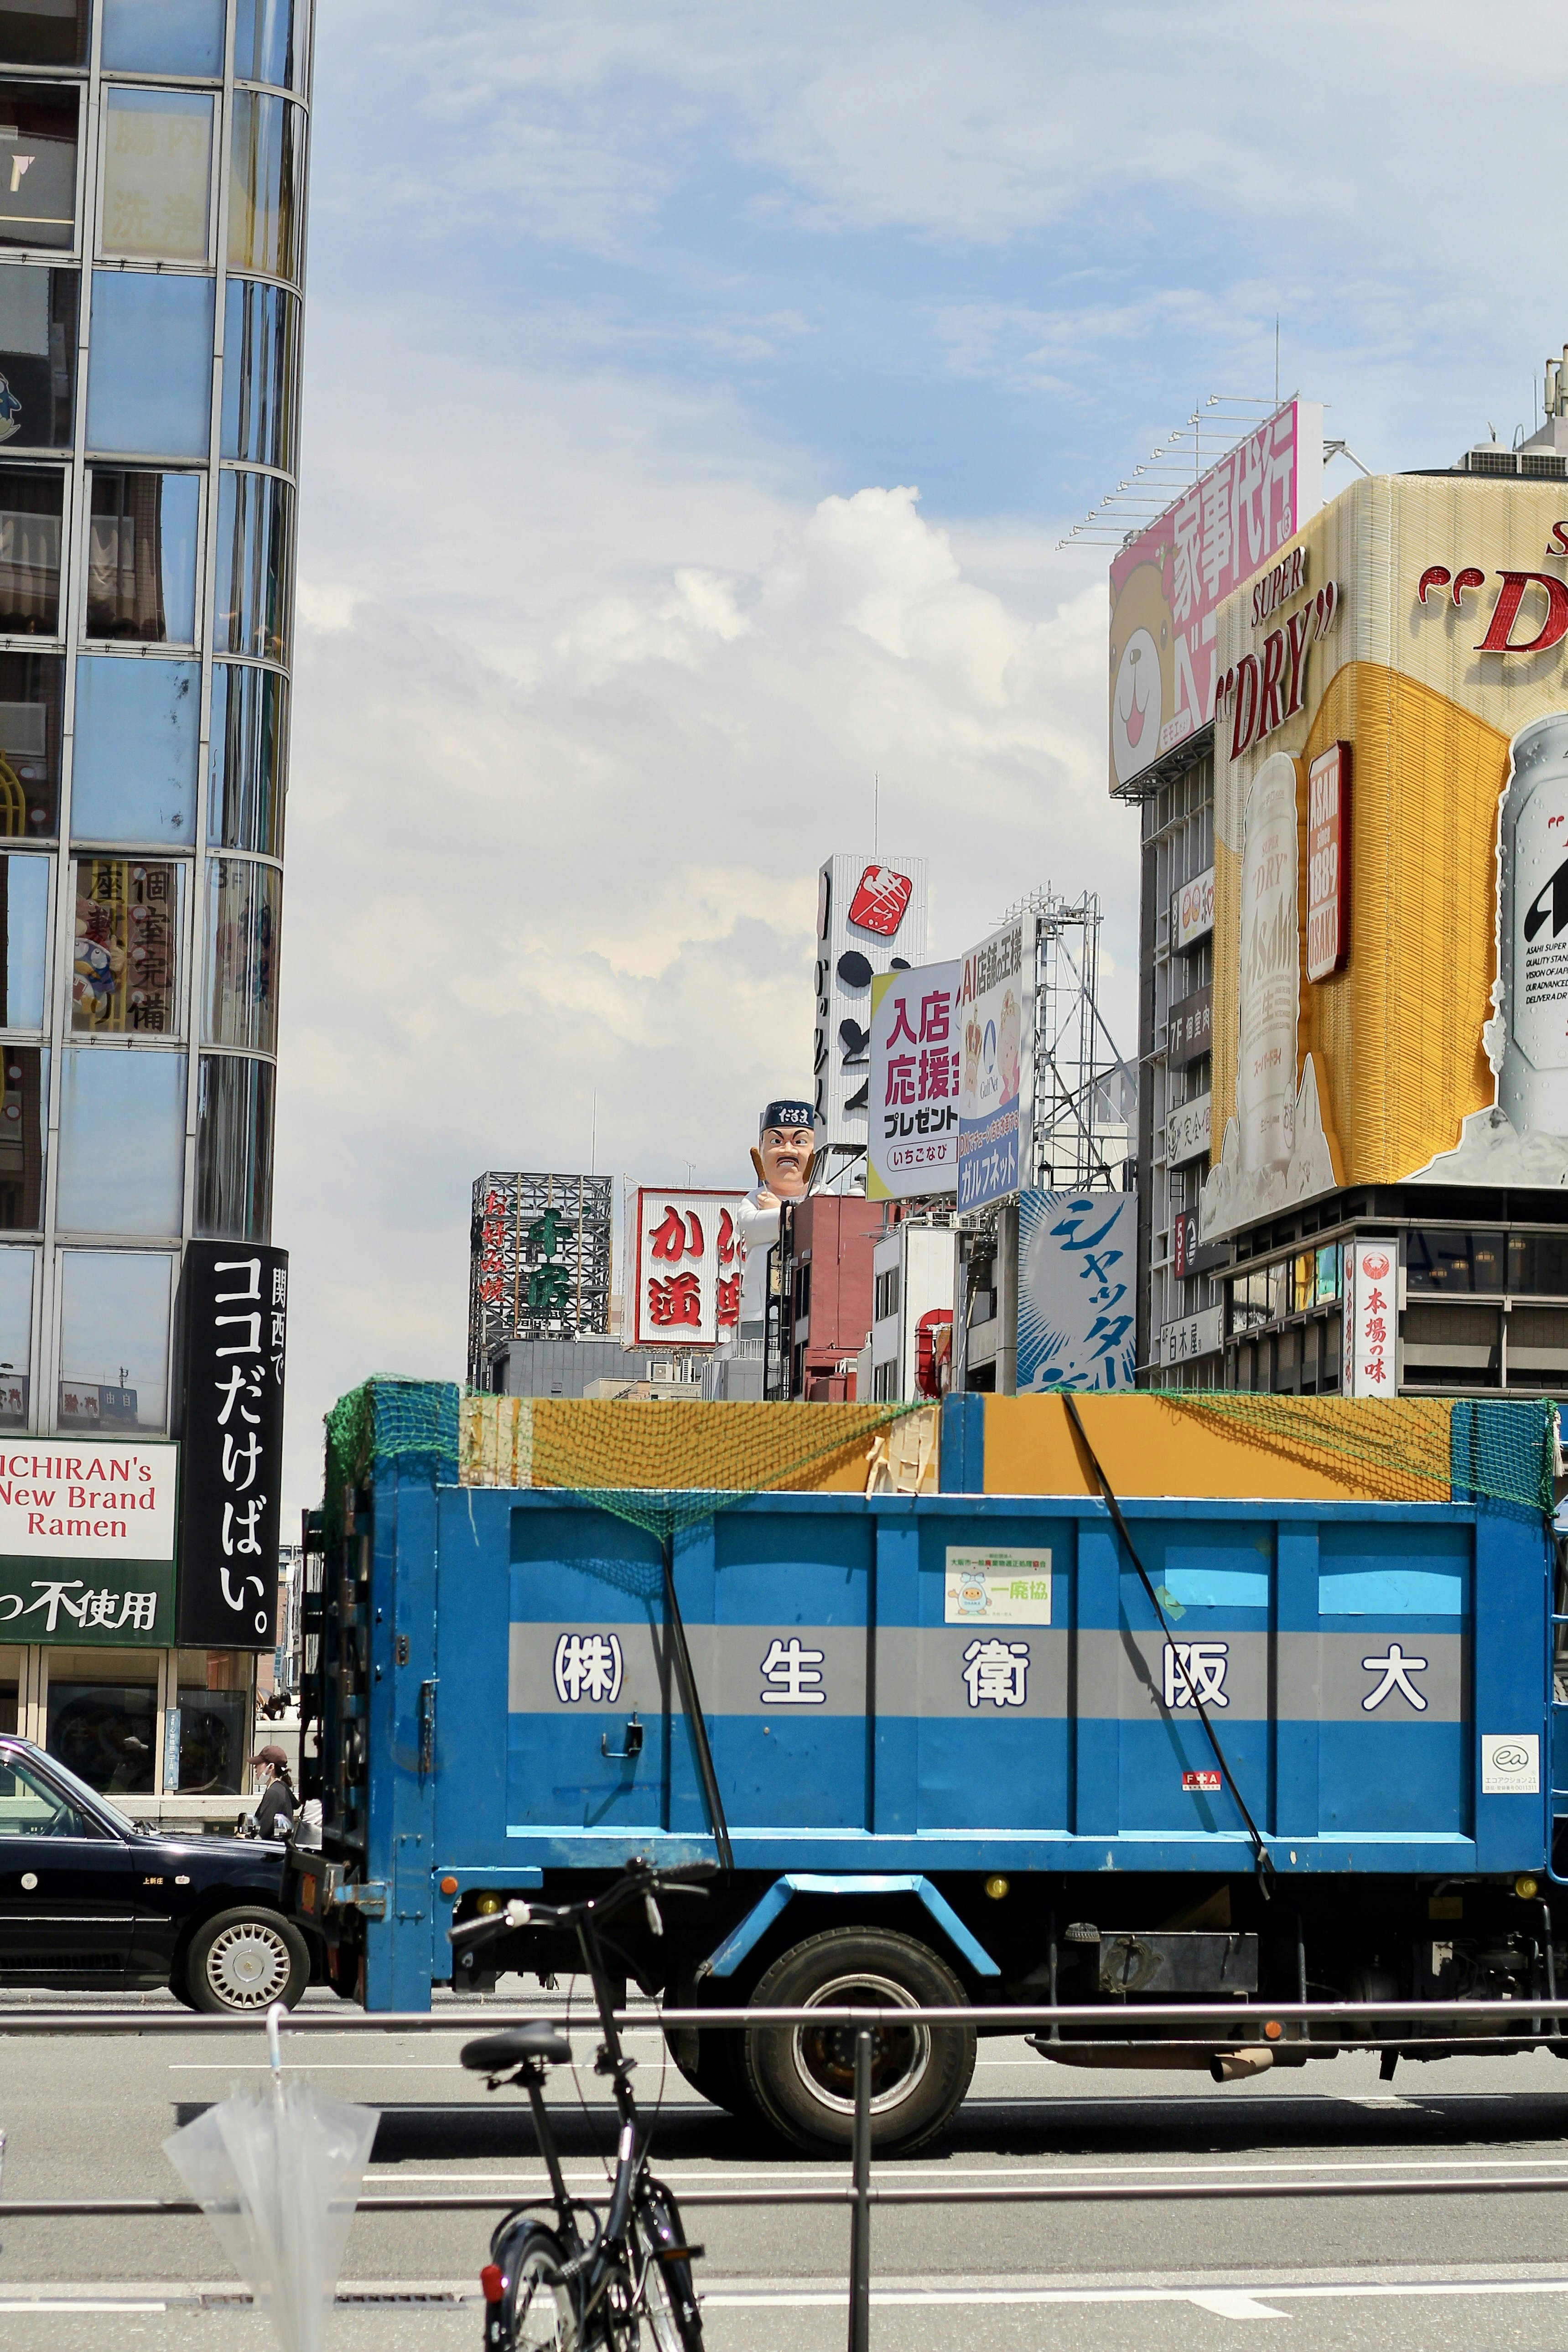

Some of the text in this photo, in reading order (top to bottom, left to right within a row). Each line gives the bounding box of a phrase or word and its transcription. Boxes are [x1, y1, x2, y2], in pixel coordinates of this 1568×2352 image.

[1252, 546, 1306, 628] SUPER
[1310, 763, 1338, 830] ASAHI
[1262, 835, 1279, 857] SUPER
[1317, 826, 1330, 850] since
[1310, 842, 1338, 906] 1889
[1172, 900, 1178, 947] 8F
[1310, 904, 1337, 969] OSAKA
[127, 871, 172, 1032] 個室完備
[1246, 891, 1292, 999] Asahi
[1526, 942, 1567, 955] ASAHI SUPER
[1526, 954, 1568, 967] QUALITY STAN
[962, 926, 1021, 1007] AI店舗の王様
[1526, 970, 1546, 980] VISION
[1262, 990, 1274, 1024] 生
[1526, 983, 1537, 992] OUR
[1526, 993, 1551, 1005] DELIVER
[1557, 992, 1568, 1000] DR
[887, 985, 961, 1050] 入店
[1171, 1017, 1183, 1054] 7F
[1186, 1004, 1210, 1043] 個室肉
[779, 1108, 809, 1125] だるま
[884, 1105, 958, 1139] プレゼント
[960, 1110, 1019, 1158] DXでチェーン店を改革する
[893, 1143, 947, 1166] いちごなび
[961, 1141, 1016, 1205] ガルフネット
[479, 1189, 508, 1302] お好み焼
[1177, 1222, 1183, 1272] 5F
[1049, 1199, 1135, 1389] シャッター
[270, 1267, 287, 1386] 関西で
[1169, 1323, 1198, 1361] 白木屋
[1364, 1288, 1387, 1384] 本場の味
[214, 1257, 268, 1634] ココだけばい。
[0, 1455, 151, 1482] ICHIRAN's
[68, 1486, 156, 1510] Brand
[28, 1512, 127, 1537] Ramen
[991, 1580, 1048, 1600] 一廃協
